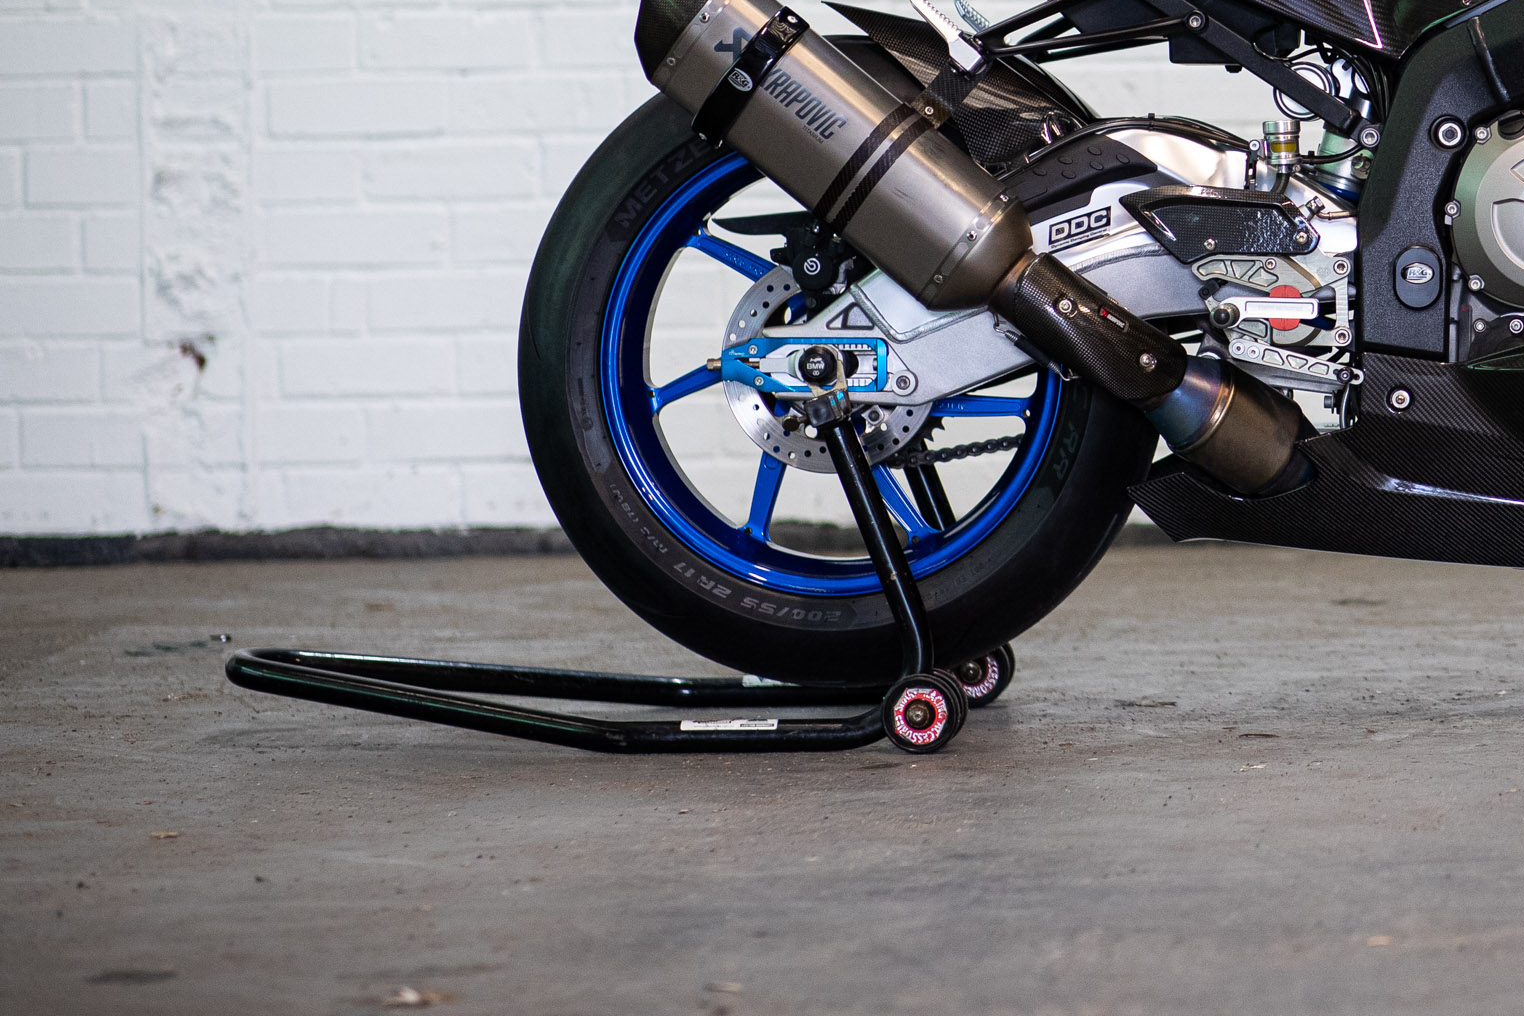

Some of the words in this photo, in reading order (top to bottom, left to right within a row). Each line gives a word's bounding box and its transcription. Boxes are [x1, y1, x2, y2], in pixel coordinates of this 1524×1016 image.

[614, 141, 712, 228] METZE
[1051, 209, 1108, 242] DDC
[807, 362, 824, 370] BMW
[672, 560, 696, 579] 17
[739, 595, 842, 623] 200/55
